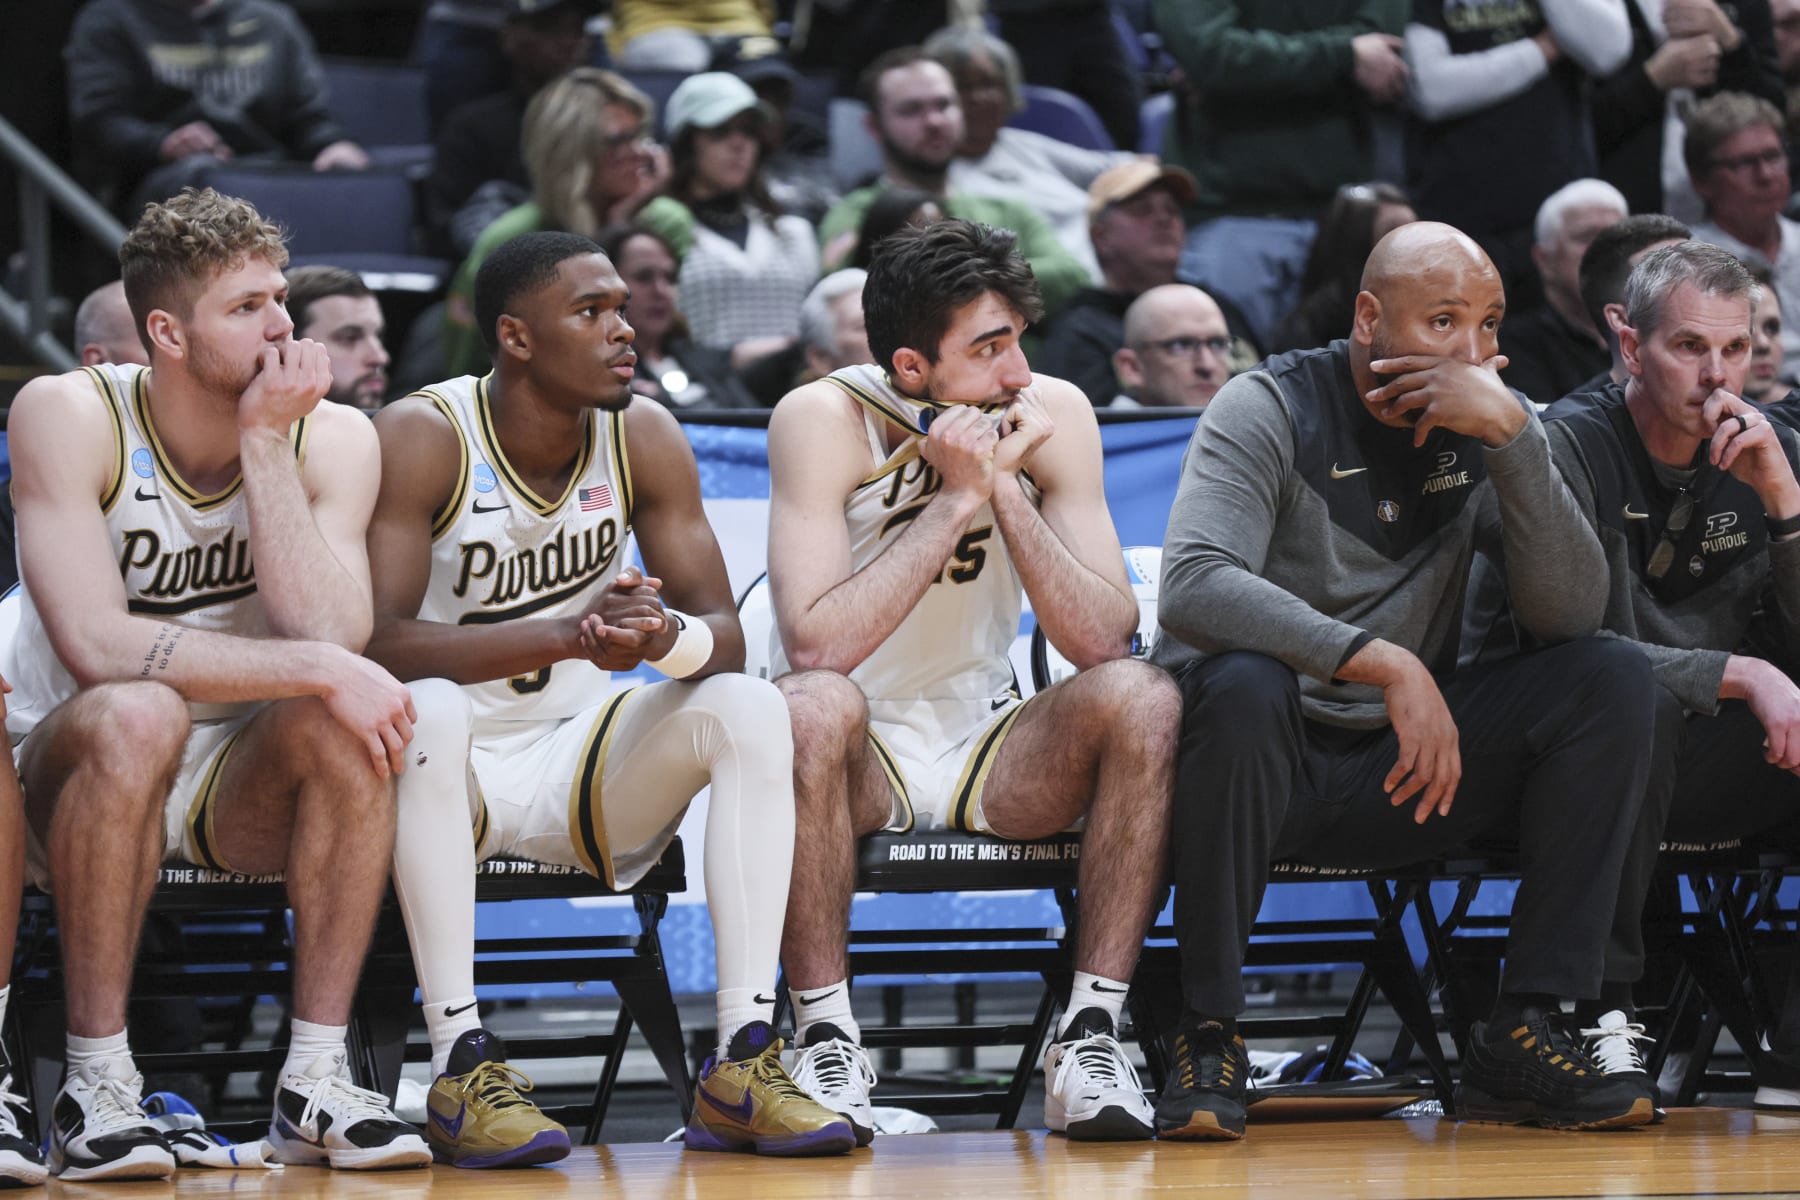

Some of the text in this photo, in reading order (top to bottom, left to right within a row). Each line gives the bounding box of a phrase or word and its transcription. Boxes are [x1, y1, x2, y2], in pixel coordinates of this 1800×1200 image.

[1422, 470, 1469, 496] PURDUE
[1705, 511, 1738, 539] P
[1701, 531, 1748, 554] PURDUE
[120, 526, 256, 599] Purdu
[452, 517, 618, 605] Purdue
[144, 642, 161, 662] live
[162, 640, 177, 656] die
[141, 664, 152, 676] to
[158, 658, 169, 670] to
[889, 843, 1080, 861] ROAD TO THE MEN'S FINAL FO
[165, 869, 194, 884] THE
